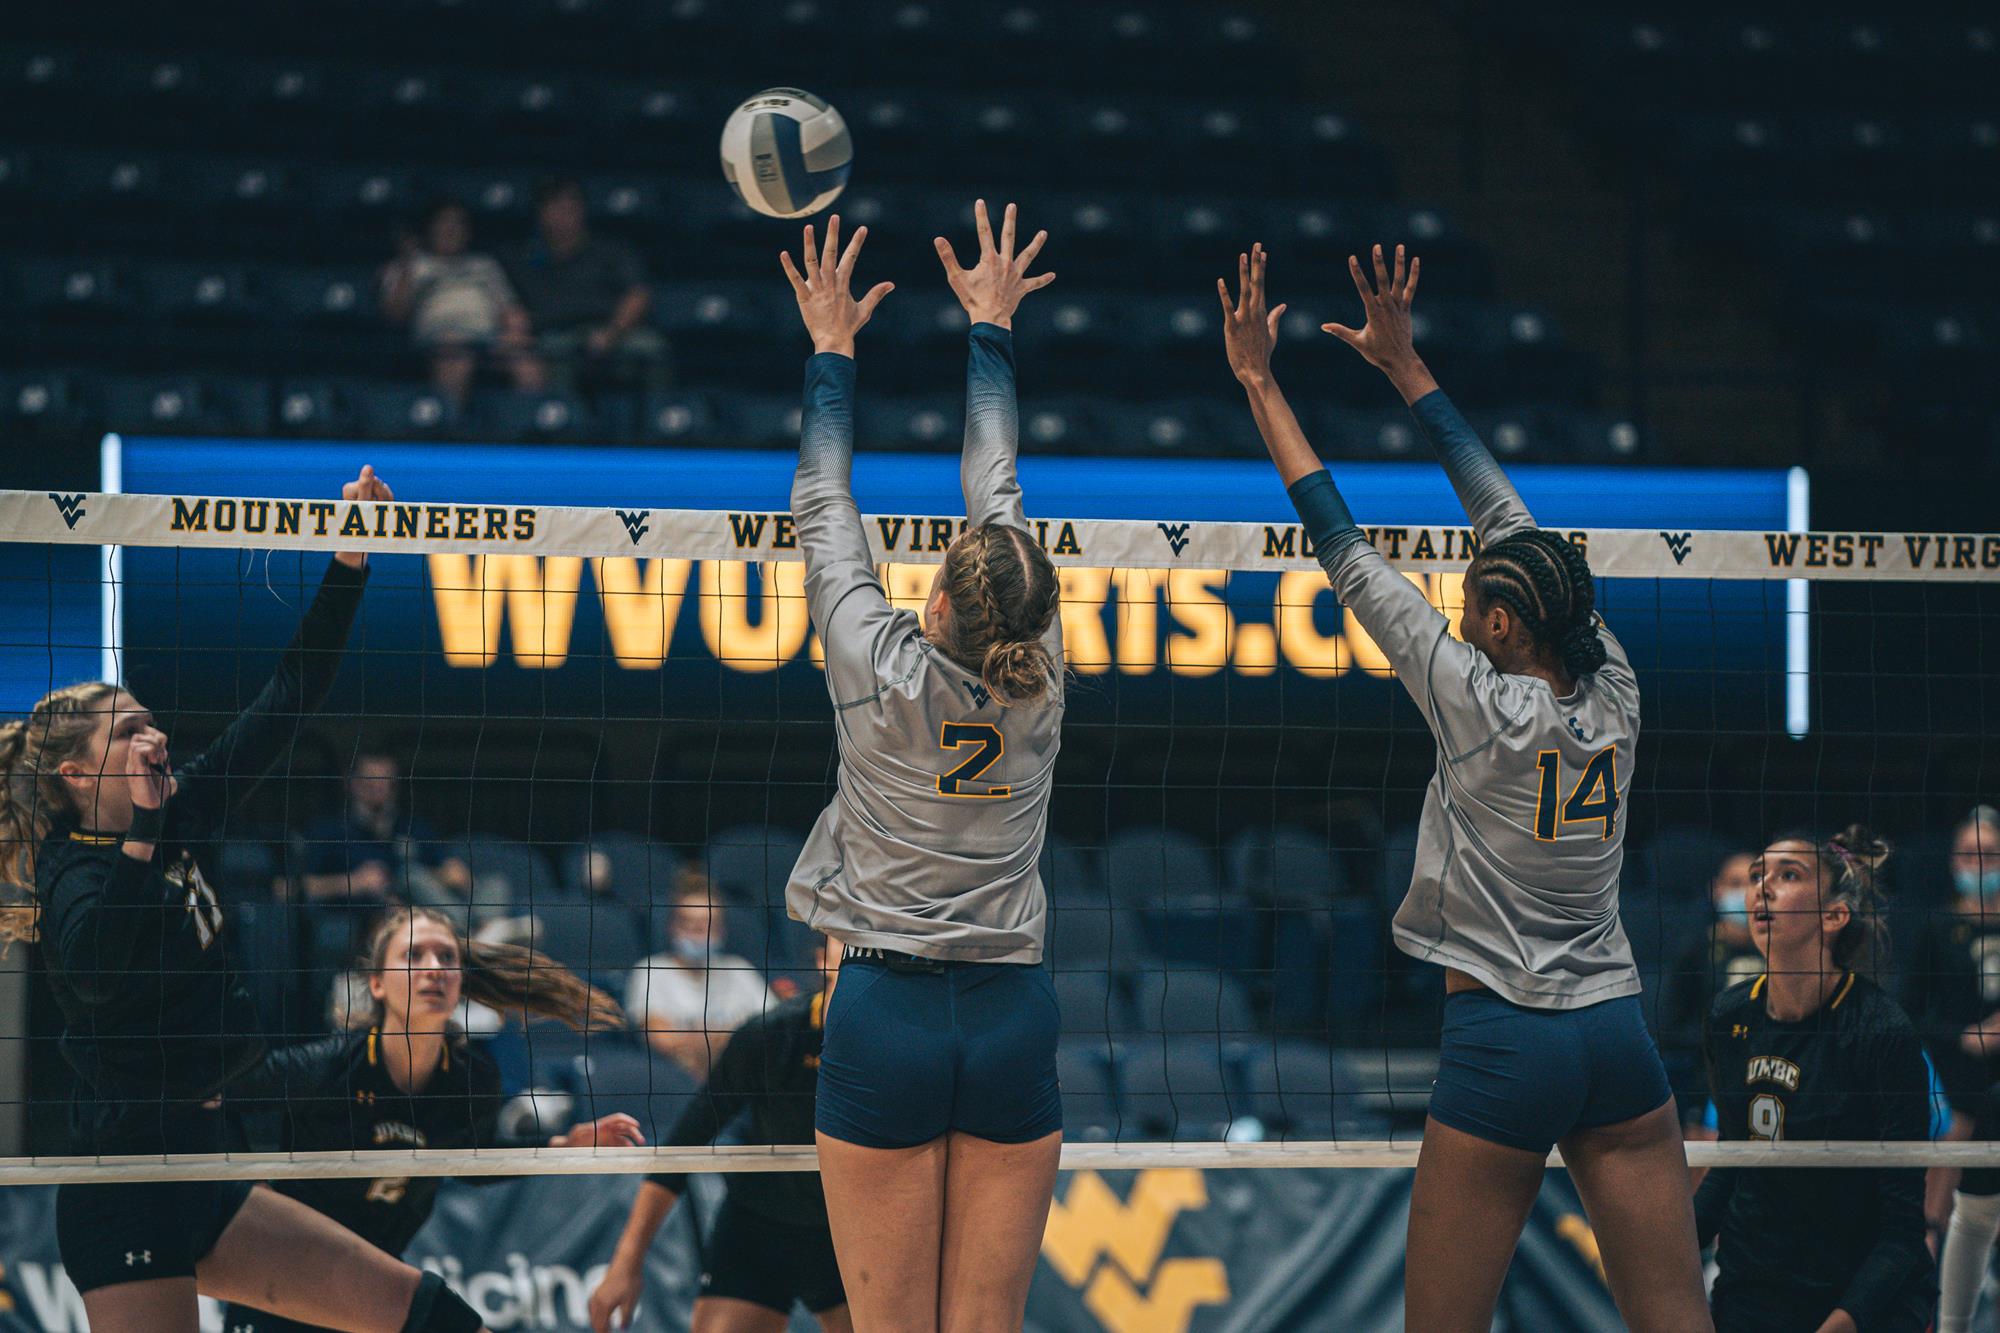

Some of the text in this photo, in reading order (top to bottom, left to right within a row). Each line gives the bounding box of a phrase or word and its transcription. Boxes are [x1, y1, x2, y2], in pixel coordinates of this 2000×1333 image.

[170, 497, 536, 541] MOUNTAINEERS
[728, 513, 1082, 555] WE VIRIA
[1764, 533, 1885, 569] WEST
[936, 720, 1011, 798] 2
[1534, 743, 1620, 842] 14
[1745, 1055, 1801, 1092] UMBC
[1748, 1093, 1785, 1141] 9
